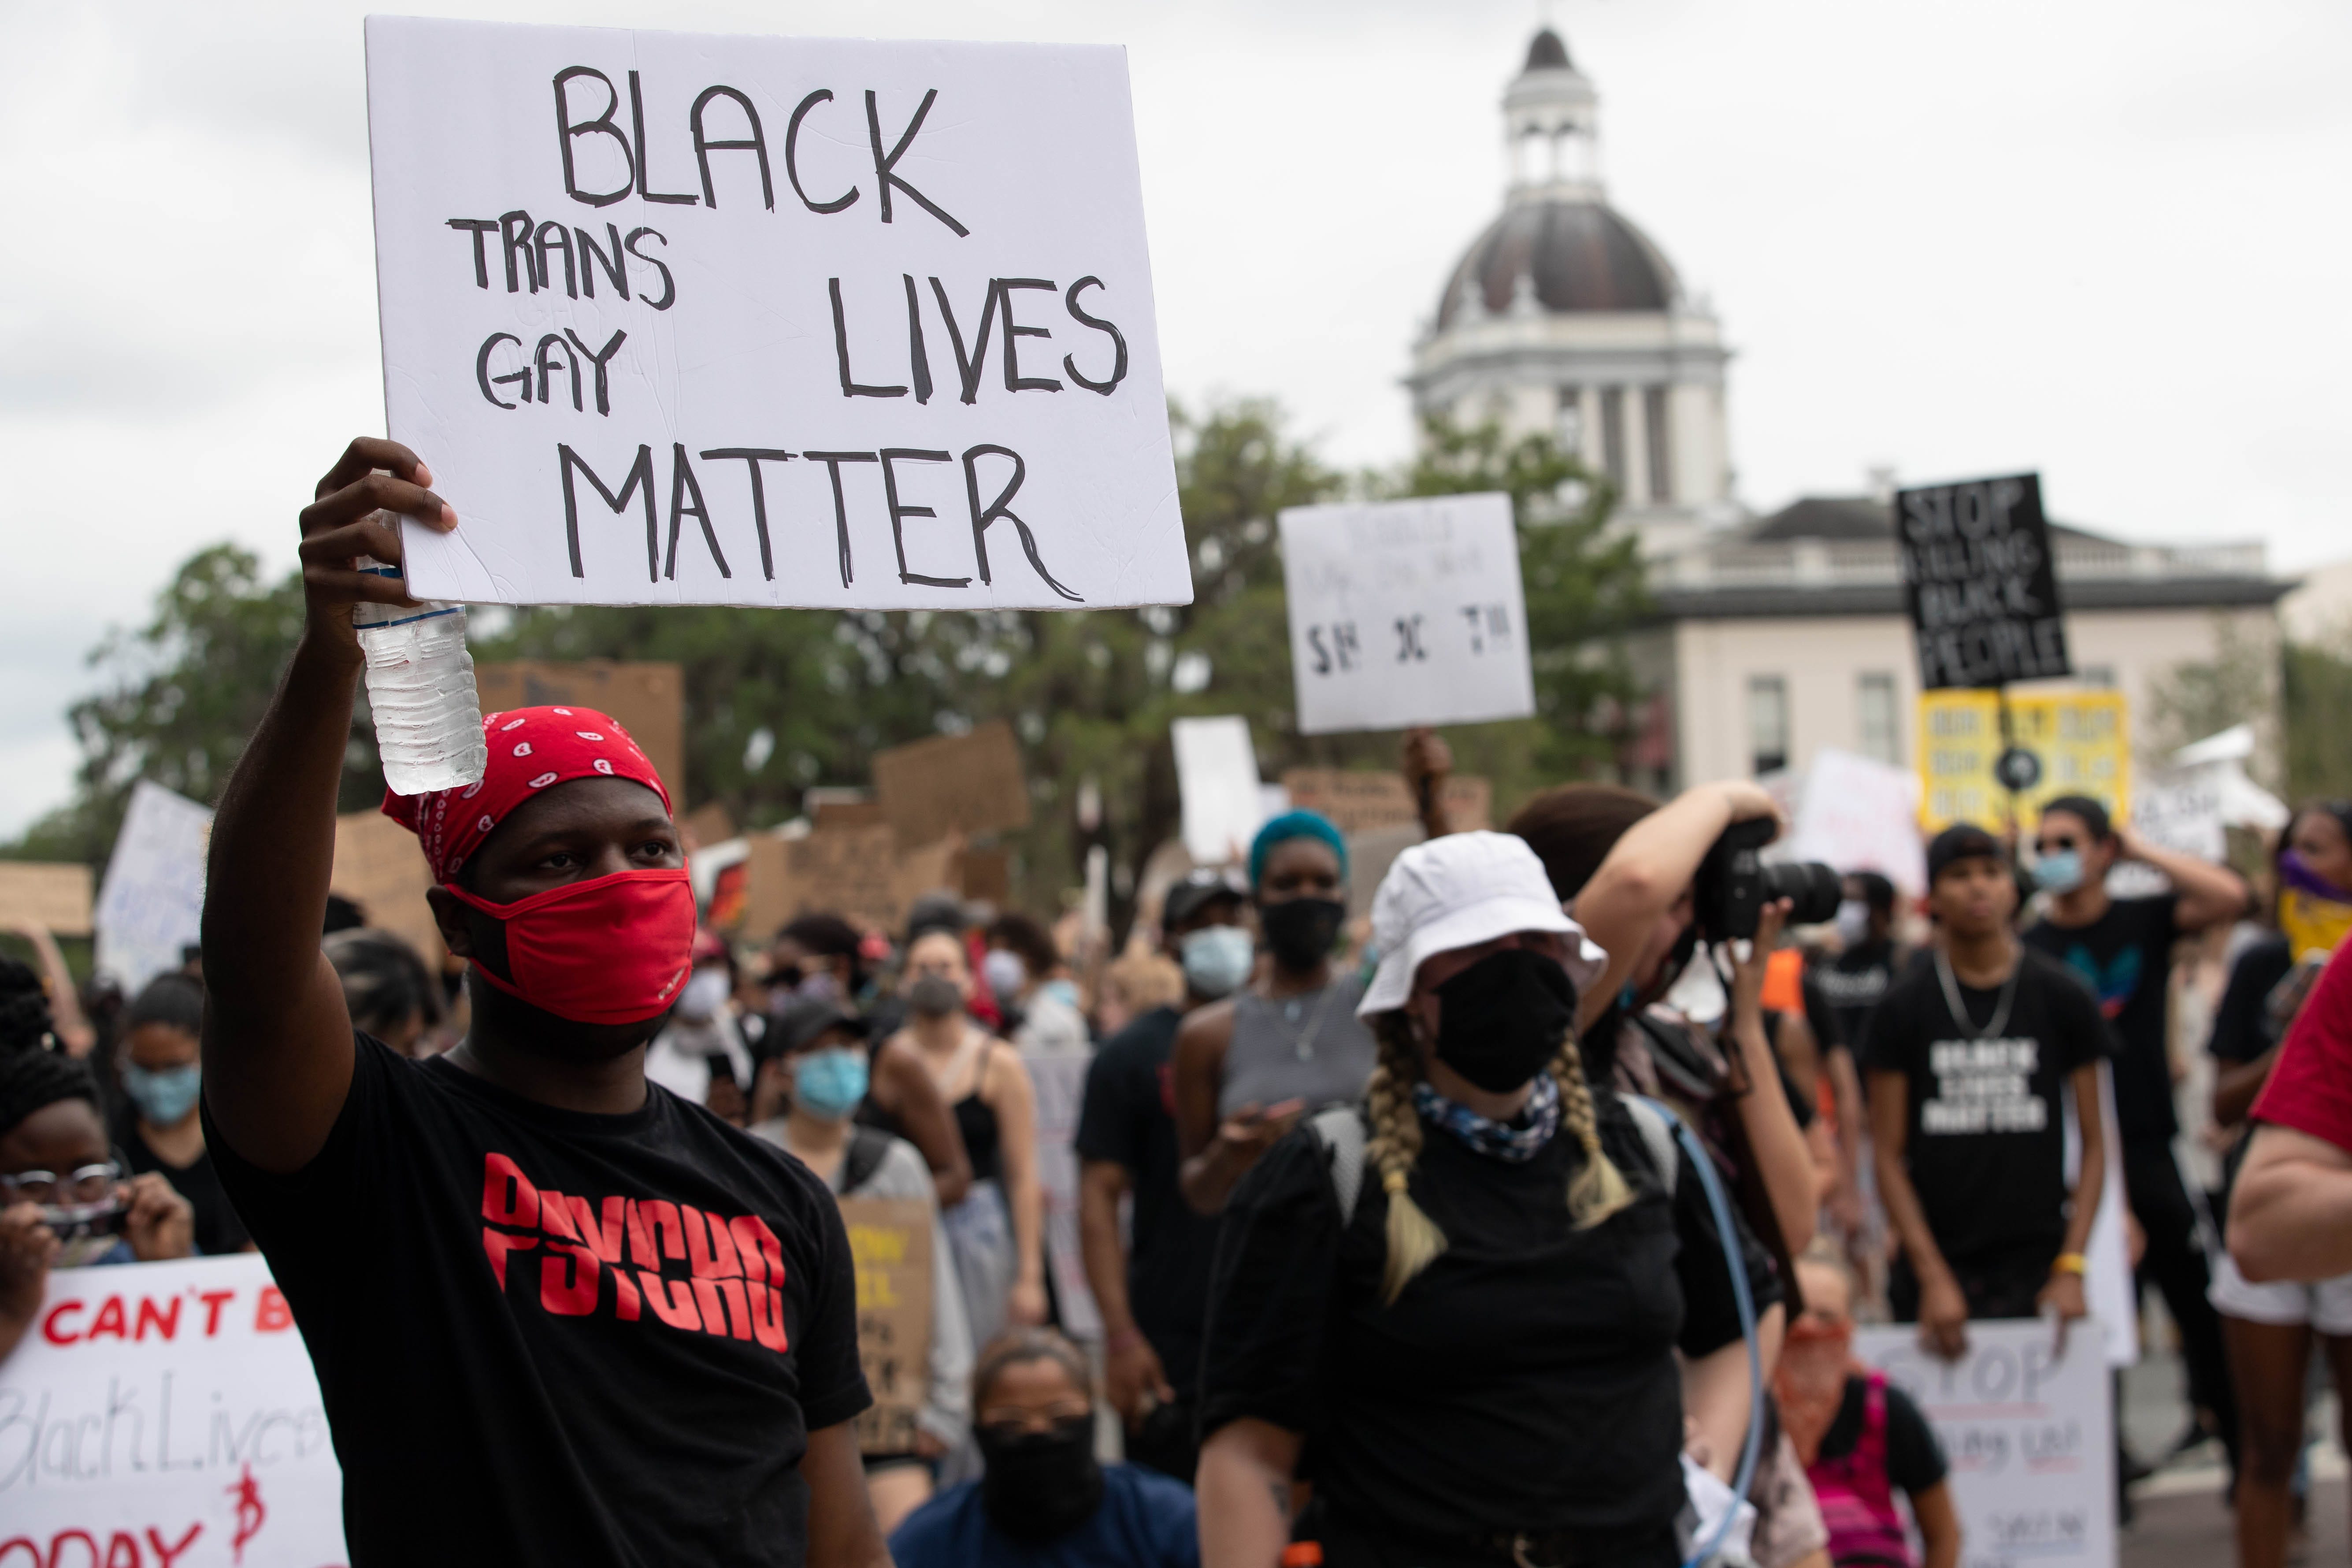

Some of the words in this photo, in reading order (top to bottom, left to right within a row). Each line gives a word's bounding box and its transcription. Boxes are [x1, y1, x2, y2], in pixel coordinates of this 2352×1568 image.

[553, 66, 969, 237] BLACK
[445, 210, 675, 310] TRANS
[476, 327, 626, 416] GAY
[829, 273, 1128, 405] LIVES
[557, 442, 1084, 602] MATTER
[1904, 478, 2026, 543] STOP
[1917, 618, 2068, 688] PEOPLE
[481, 1152, 789, 1354] PSYCHO
[41, 1286, 237, 1348] CAN'T
